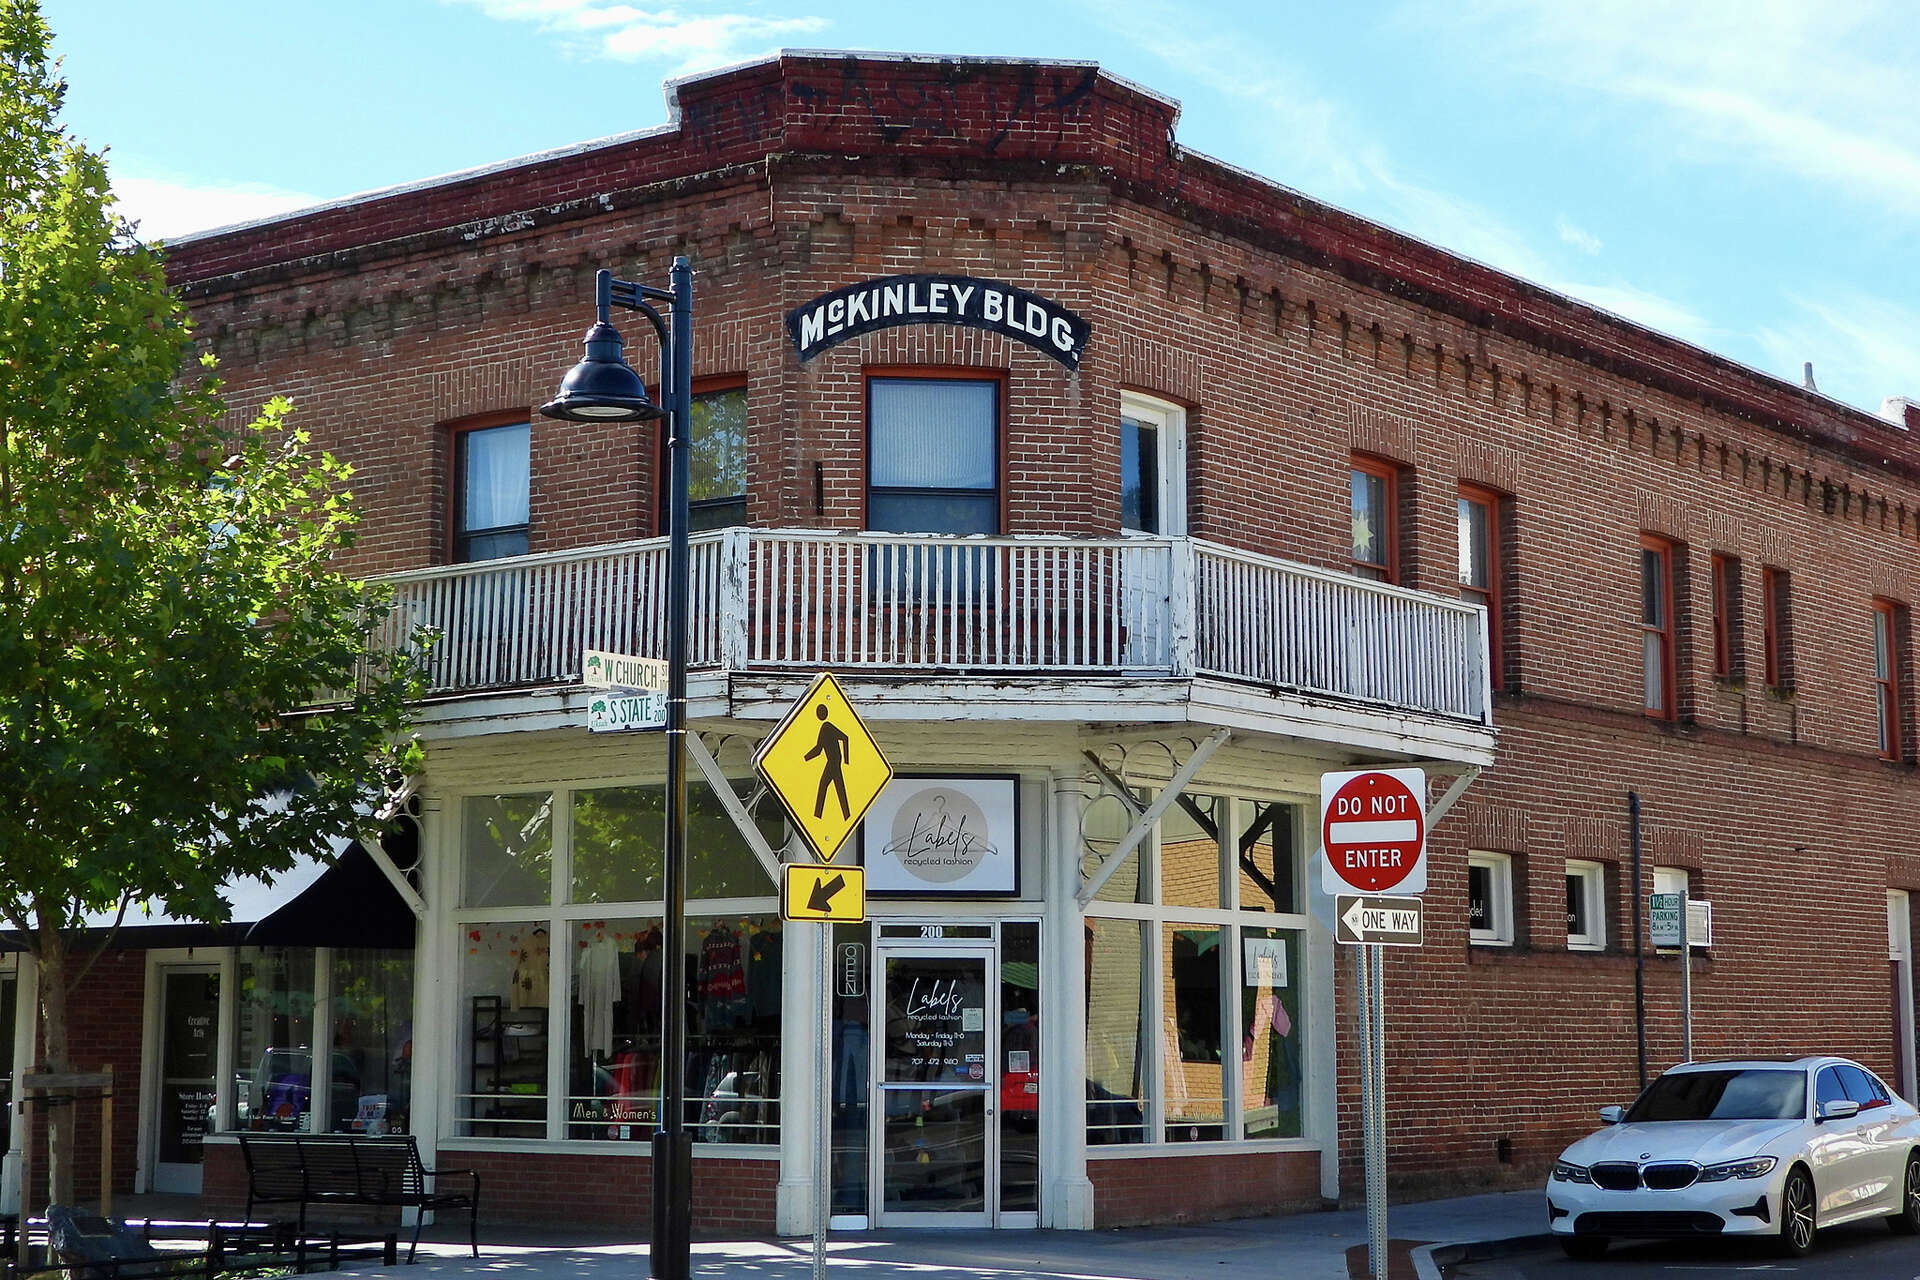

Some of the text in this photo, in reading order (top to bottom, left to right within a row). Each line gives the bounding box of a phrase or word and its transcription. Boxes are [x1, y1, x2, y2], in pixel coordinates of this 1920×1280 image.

[984, 289, 1079, 361] BLDG.
[605, 660, 613, 682] W
[616, 660, 658, 688] CHURCH
[610, 693, 664, 724] S STATE ST
[653, 709, 666, 722] 200
[1338, 795, 1408, 816] DO NOT
[907, 812, 976, 858] Labels
[904, 857, 973, 867] recycled fashion
[1345, 849, 1402, 868] ENTER
[1362, 910, 1387, 930] ONE
[1391, 913, 1417, 931] WAY
[1652, 911, 1679, 921] PARKING
[920, 925, 943, 938] 200
[845, 945, 858, 995] OPEN
[906, 976, 964, 1015] Labels
[907, 1012, 938, 1022] recycled
[938, 1013, 963, 1022] fashion
[905, 1032, 930, 1040] Monday
[916, 1040, 942, 1048] Saturday
[573, 1103, 657, 1120] Men & Women's
